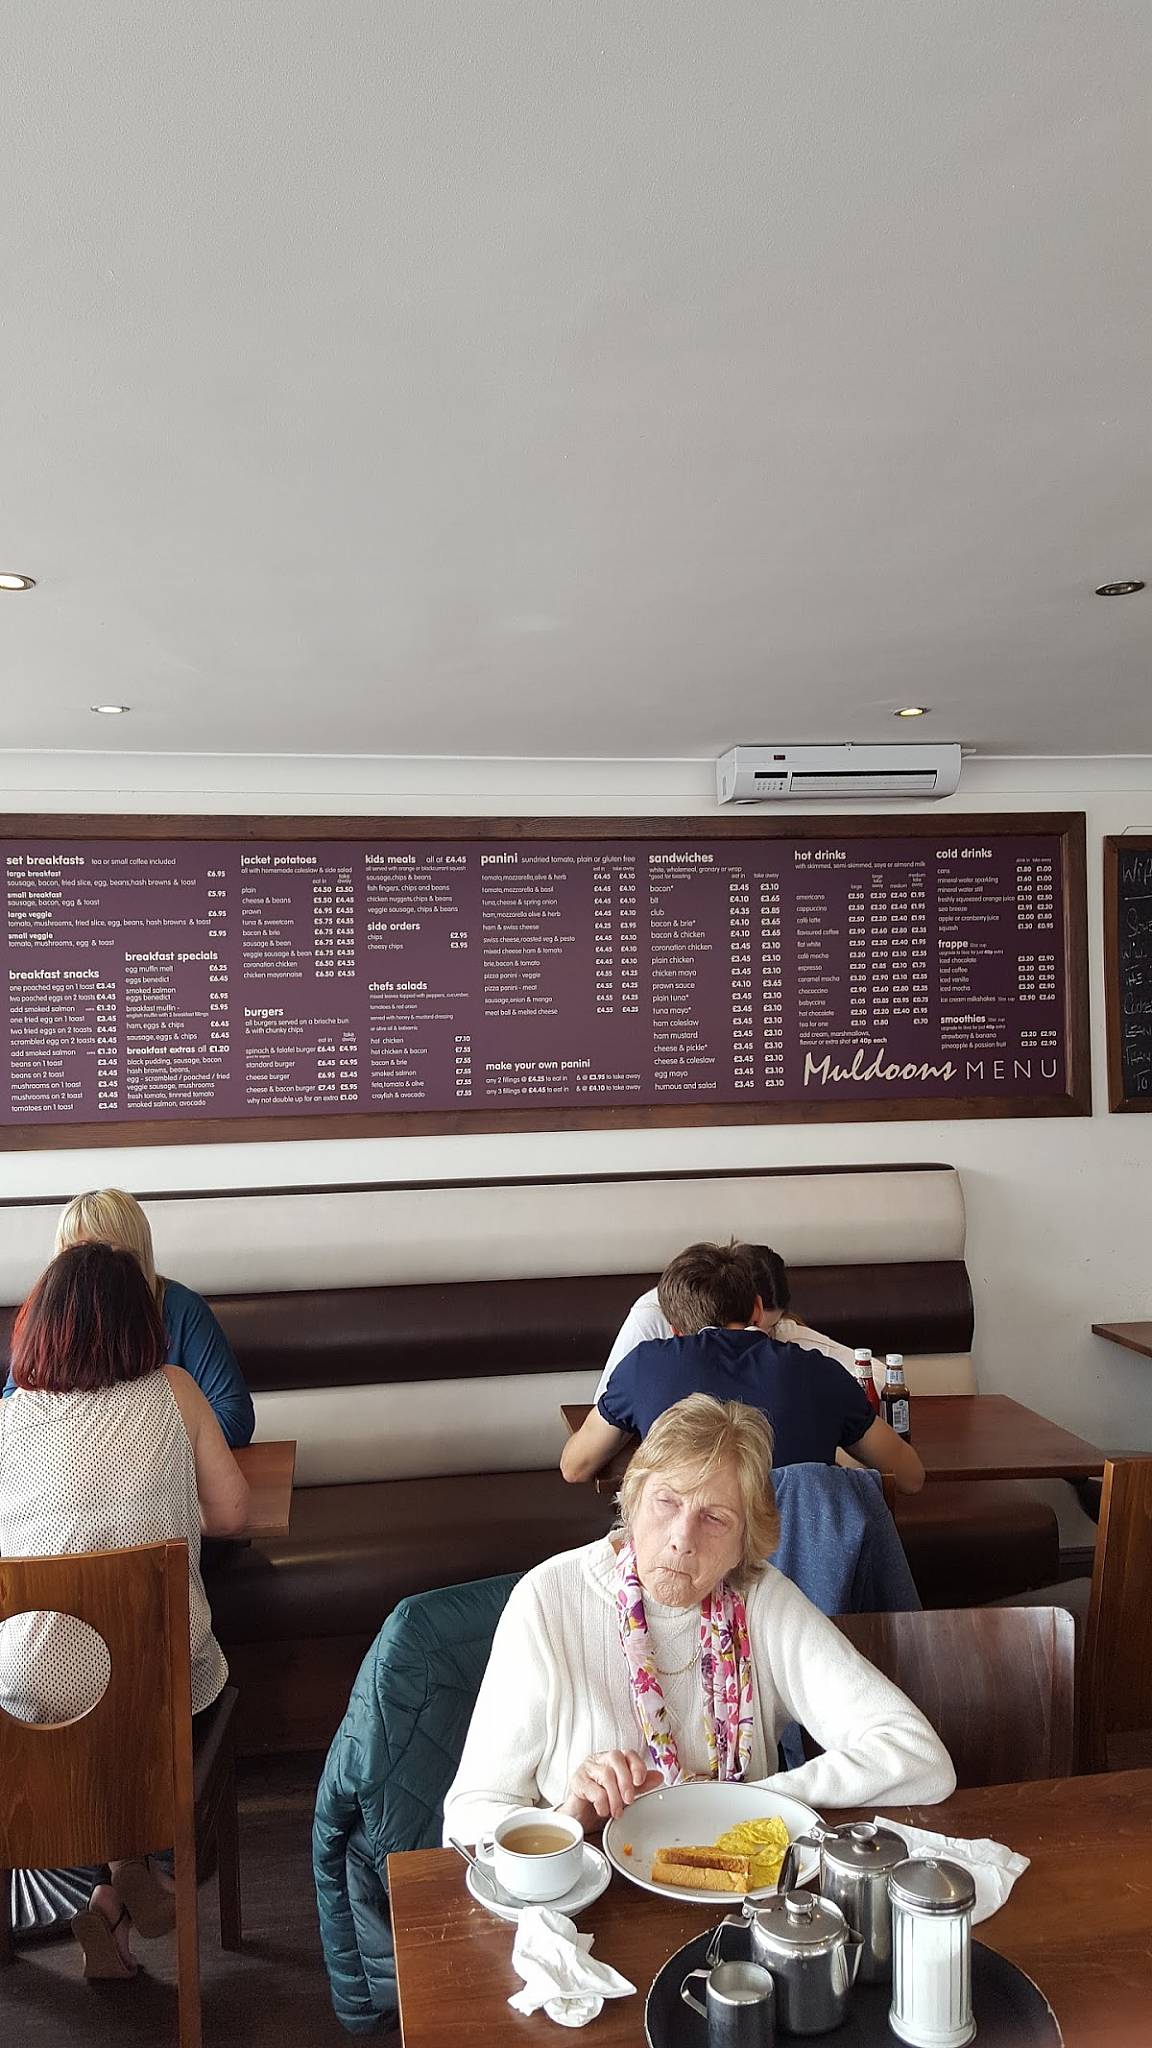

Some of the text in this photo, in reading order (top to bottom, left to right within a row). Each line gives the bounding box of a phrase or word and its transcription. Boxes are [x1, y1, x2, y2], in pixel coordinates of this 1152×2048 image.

[649, 853, 713, 863] sandwiches
[795, 850, 846, 860] hot drinks
[936, 848, 992, 859] cold drinks
[7, 856, 84, 865] set breakfasts
[241, 855, 317, 866] jacket potatoes
[366, 855, 385, 864] kids
[387, 855, 416, 864] meals
[481, 853, 518, 866] panini
[577, 855, 592, 864] plain
[602, 856, 622, 864] gluten
[8, 911, 26, 919] large
[368, 922, 420, 931] side orders
[368, 933, 382, 941] chips
[938, 940, 968, 949] frappe
[125, 951, 218, 962] breakfast specials
[9, 970, 99, 979] breakfast snacks
[125, 966, 137, 974] egg
[652, 969, 696, 978] chicken mayo
[210, 975, 228, 983] £6.45
[368, 981, 427, 990] chefs salads
[653, 983, 673, 991] prawn
[245, 1008, 284, 1018] burgers
[941, 1015, 985, 1024] smoothies
[670, 1031, 698, 1039] mustard
[11, 1038, 45, 1046] scrambled
[127, 1046, 167, 1054] breakfast
[170, 1046, 195, 1054] extras
[275, 1060, 295, 1068] burger
[317, 1059, 335, 1067] £6.45
[486, 1059, 590, 1071] make your own panini
[804, 1048, 1057, 1086] Muldoons MENU
[270, 1073, 290, 1081] burger
[655, 1082, 682, 1090] humous
[698, 1081, 716, 1089] salad
[12, 1104, 42, 1112] tomatoes
